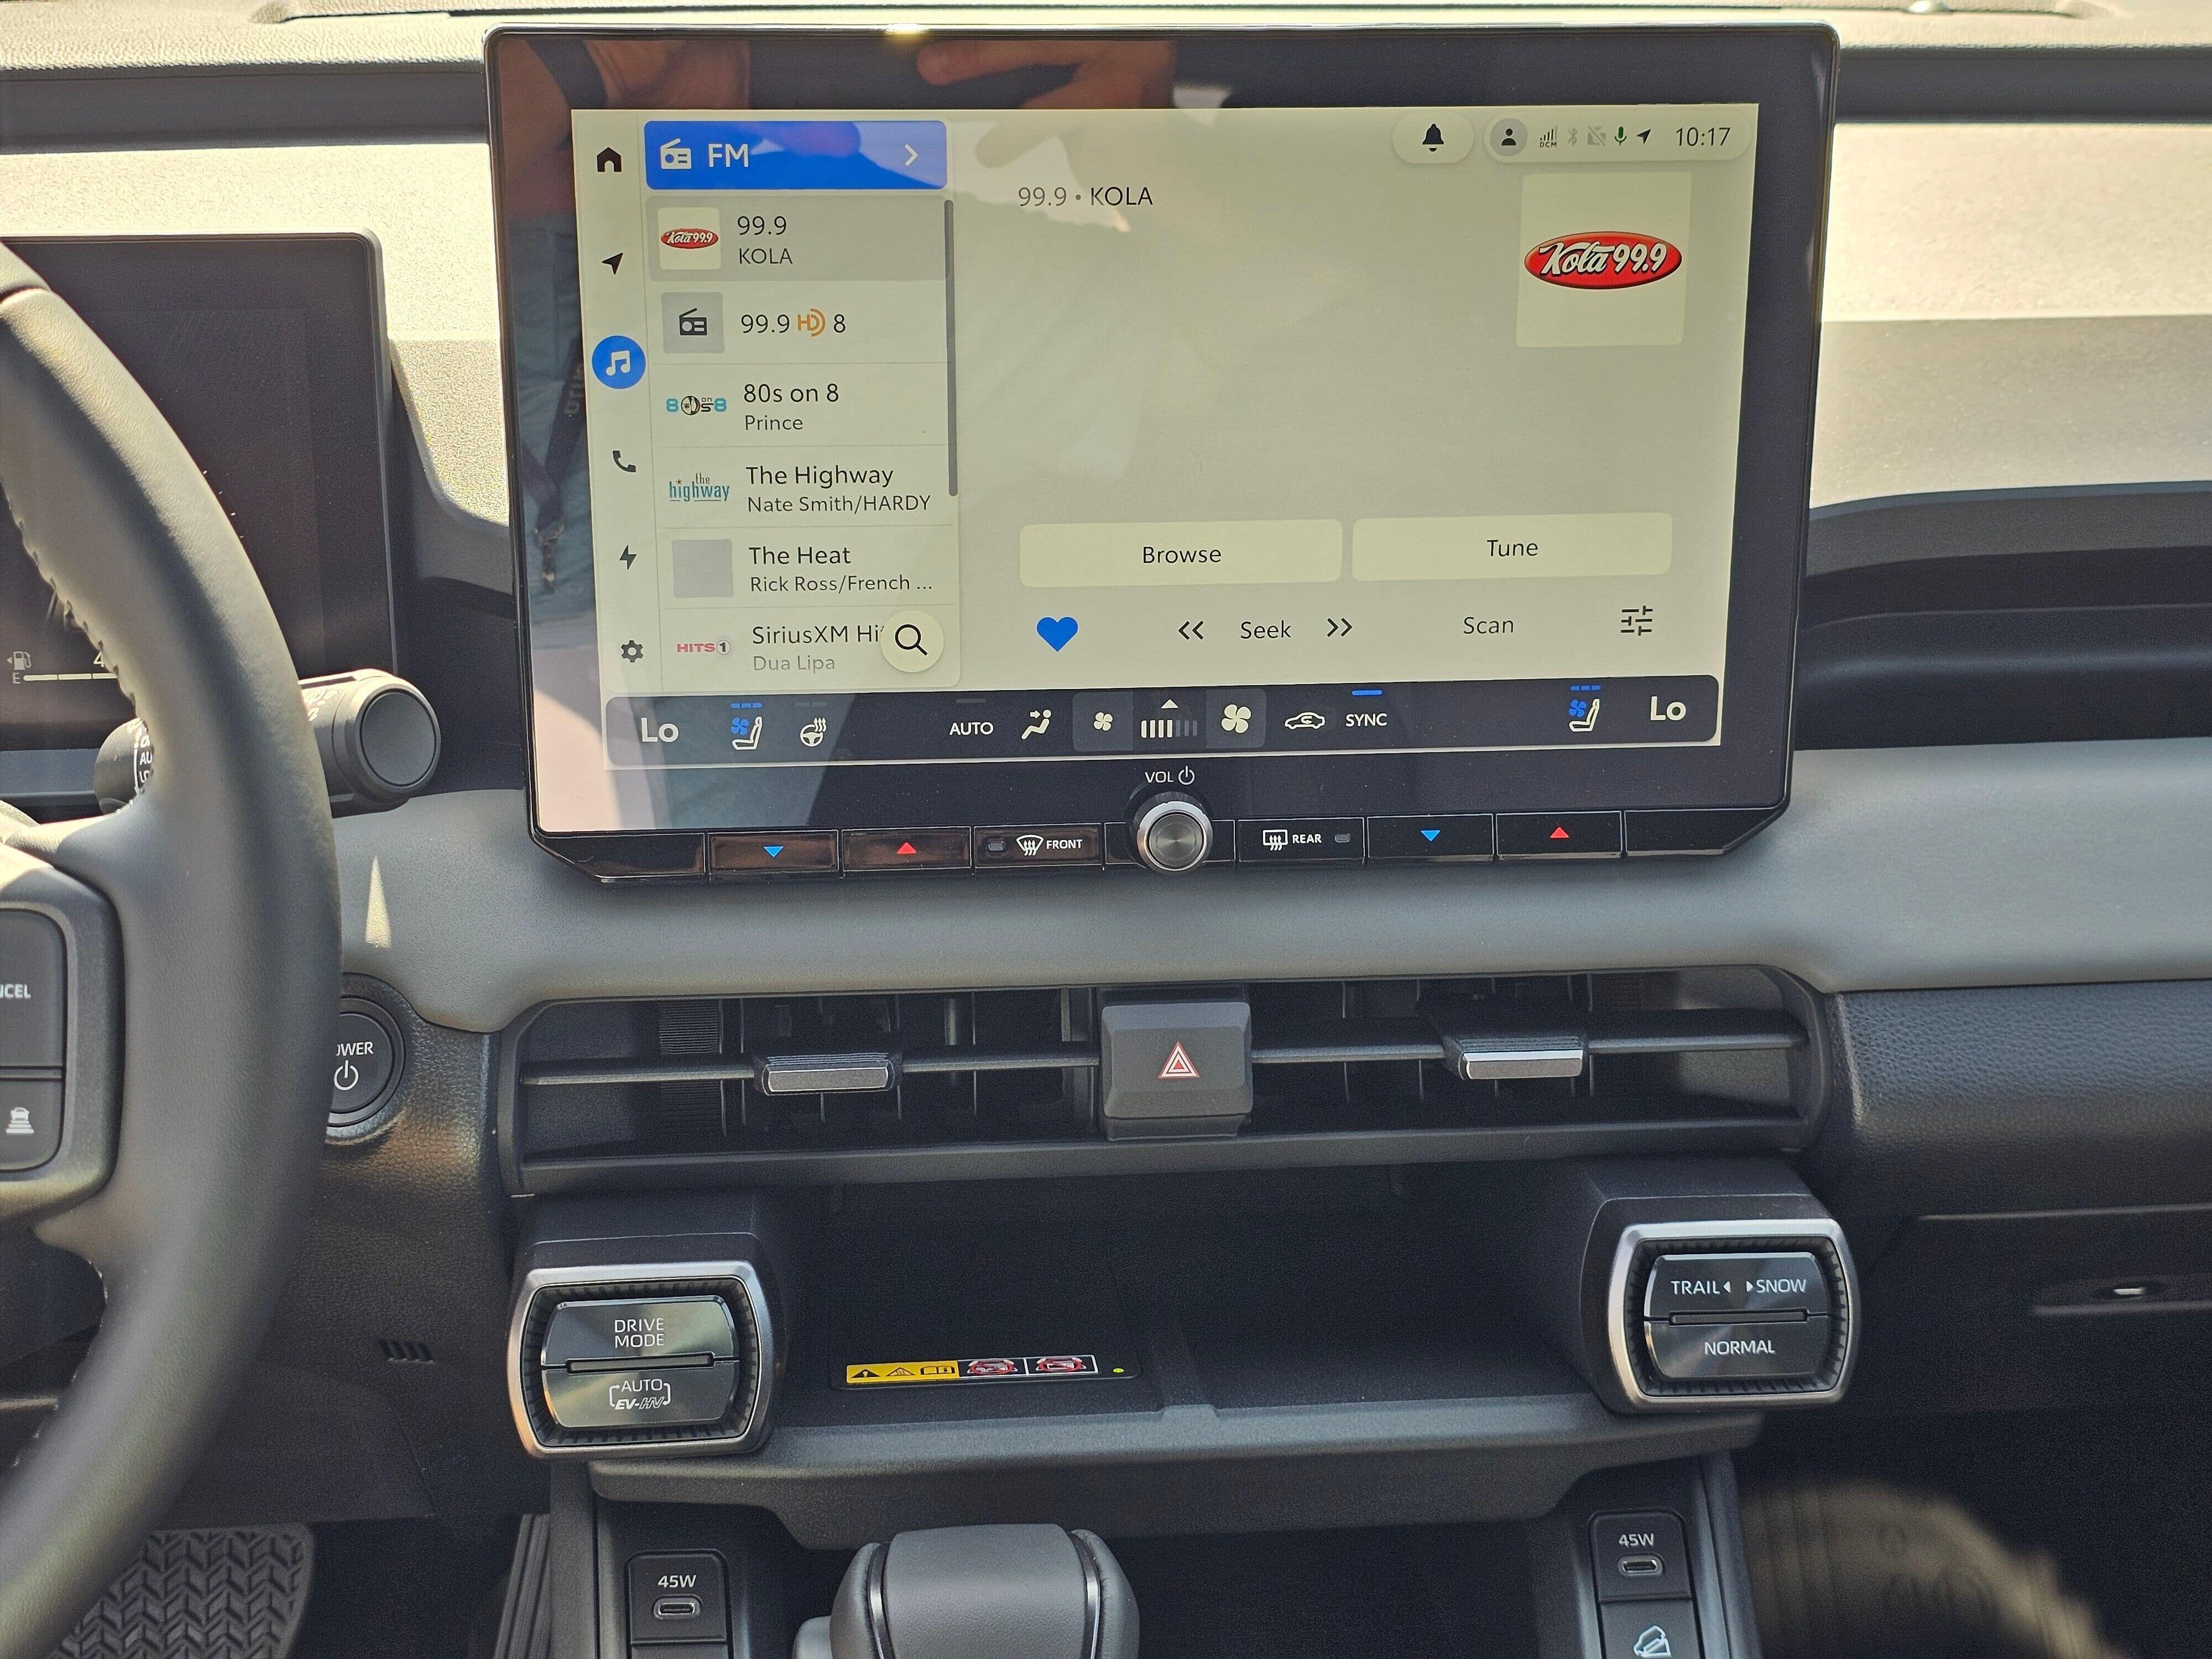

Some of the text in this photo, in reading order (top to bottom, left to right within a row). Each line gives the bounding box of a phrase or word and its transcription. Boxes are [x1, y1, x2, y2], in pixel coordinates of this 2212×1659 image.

[1676, 127, 1731, 147] 10:17
[708, 143, 749, 168] FM
[1018, 186, 1153, 207] 99.9 KOLA
[737, 216, 787, 236] 99.9
[692, 232, 713, 243] 99.9
[738, 248, 793, 265] KOLA
[1538, 241, 1667, 275] Kola 99.9
[740, 314, 790, 333] 99.9
[833, 314, 846, 333] 8
[743, 383, 839, 403] 80s on 8
[744, 414, 804, 431] Prince
[695, 472, 710, 484] the
[746, 465, 894, 488] The Highway
[669, 481, 730, 502] highway
[748, 494, 931, 514] Nate Smith/HARDY
[748, 546, 852, 565] The Heat
[1142, 544, 1222, 564] Browse
[1486, 538, 1538, 557] Tune
[750, 576, 789, 592] Rick
[795, 575, 910, 594] Ross/French
[752, 625, 848, 644] SiriusXM
[1240, 619, 1292, 639] Seek
[1463, 615, 1515, 635] Scan
[753, 655, 836, 674] Dua Lipa
[12, 672, 21, 684] E
[1650, 697, 1686, 721] Lo
[641, 717, 680, 743] Lo
[949, 722, 994, 736] AUTO
[1345, 713, 1388, 728] SYNC
[1145, 771, 1174, 784] VOL
[1046, 838, 1083, 850] FRONT
[1292, 833, 1322, 844] REAR
[1671, 1280, 1720, 1295] TRAIL
[1756, 1279, 1807, 1293] SNOW
[614, 1317, 665, 1333] DRIVE
[614, 1333, 665, 1348] MODE
[1704, 1340, 1776, 1355] NORMAL
[621, 1379, 663, 1393] AUTO
[1618, 1533, 1655, 1547] 45W
[658, 1574, 697, 1588] 45W
